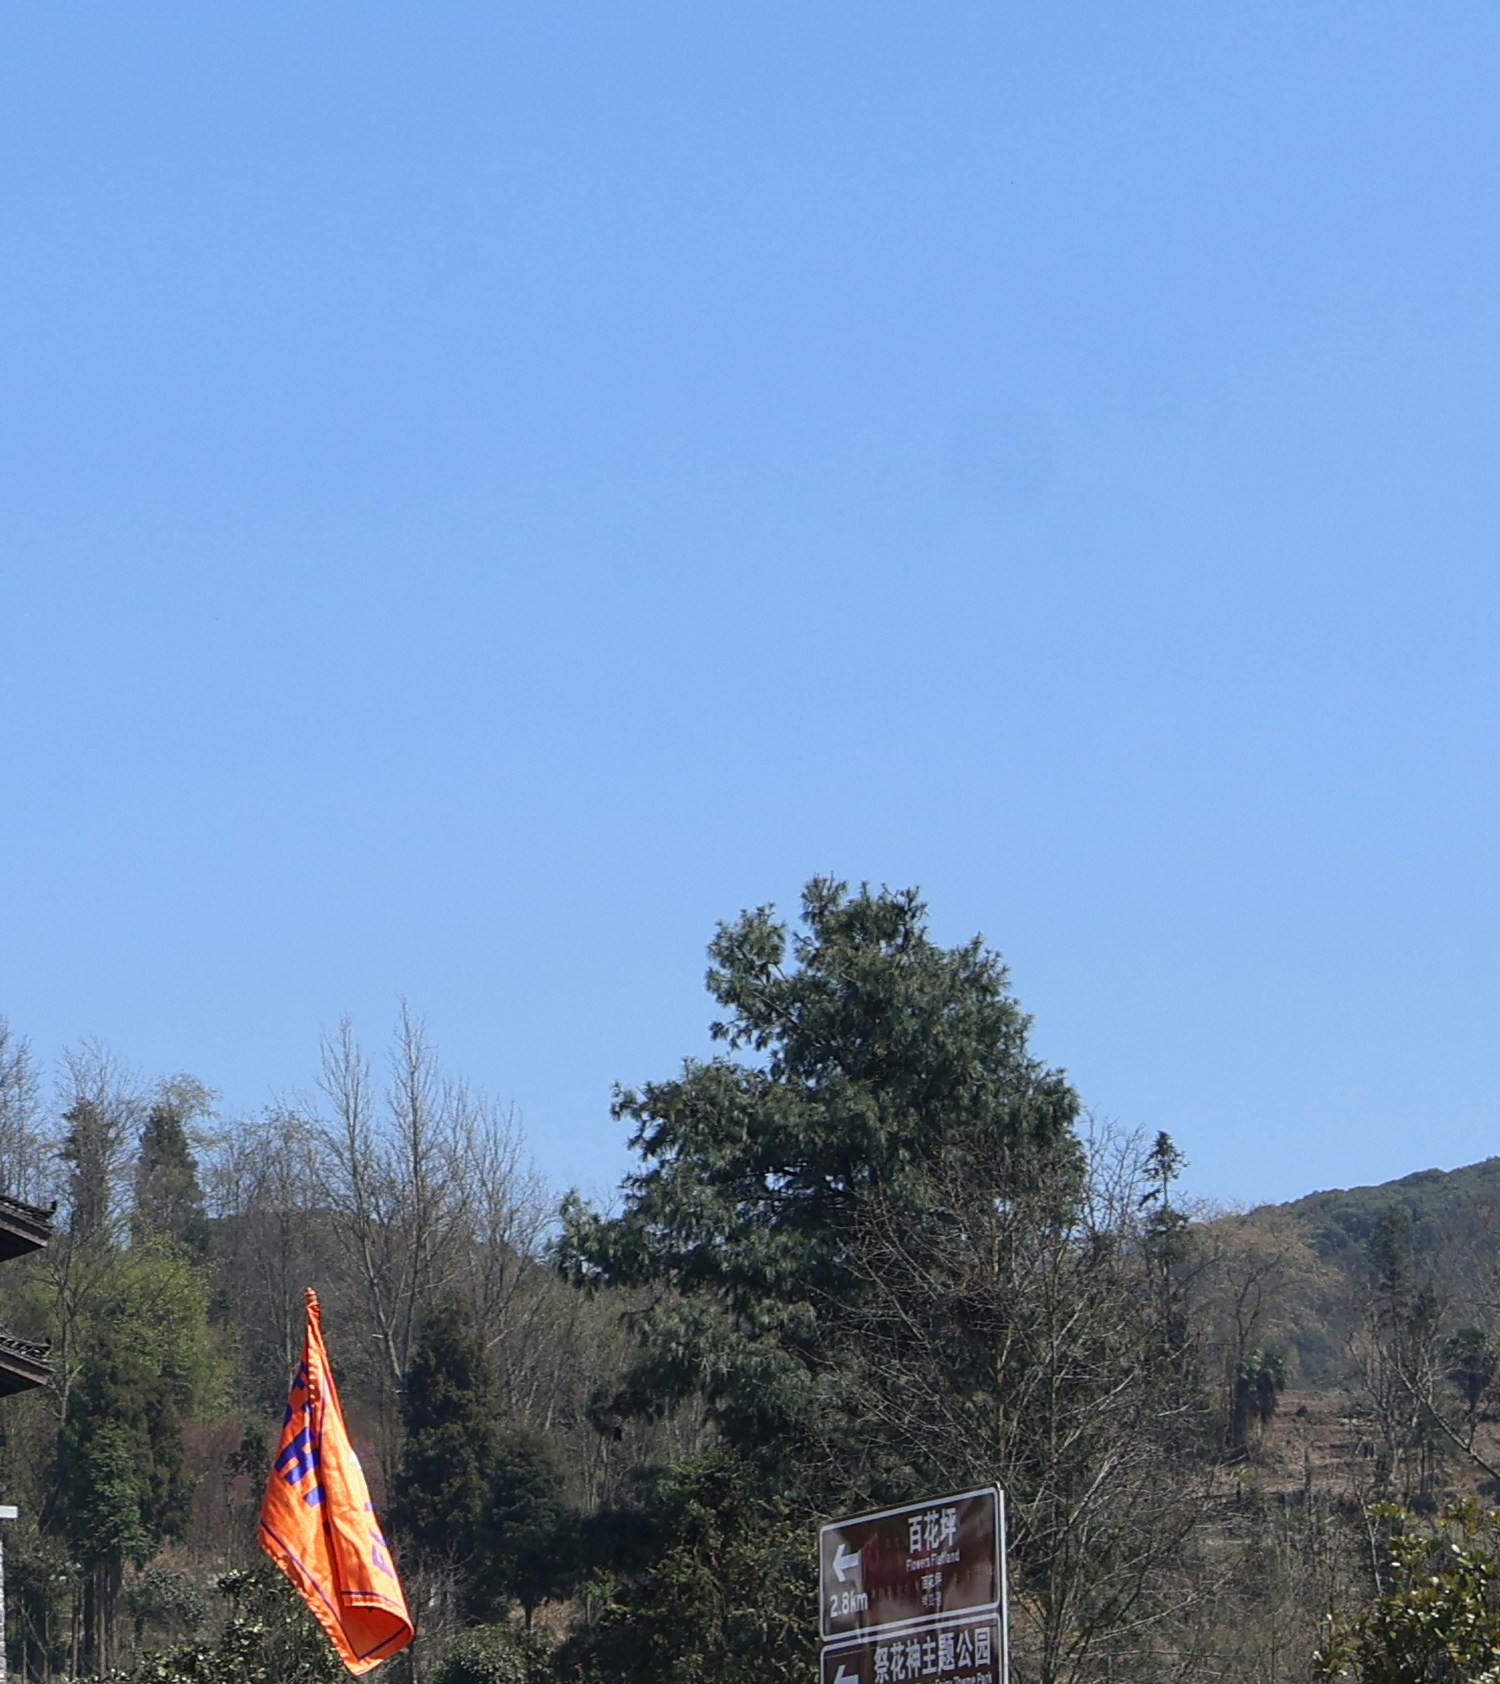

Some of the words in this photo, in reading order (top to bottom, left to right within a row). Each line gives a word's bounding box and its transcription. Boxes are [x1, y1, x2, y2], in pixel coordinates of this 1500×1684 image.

[907, 1507, 957, 1554] 百花坪
[830, 1592, 868, 1618] 2.8km
[874, 1627, 991, 1684] 祭花神主题公园
